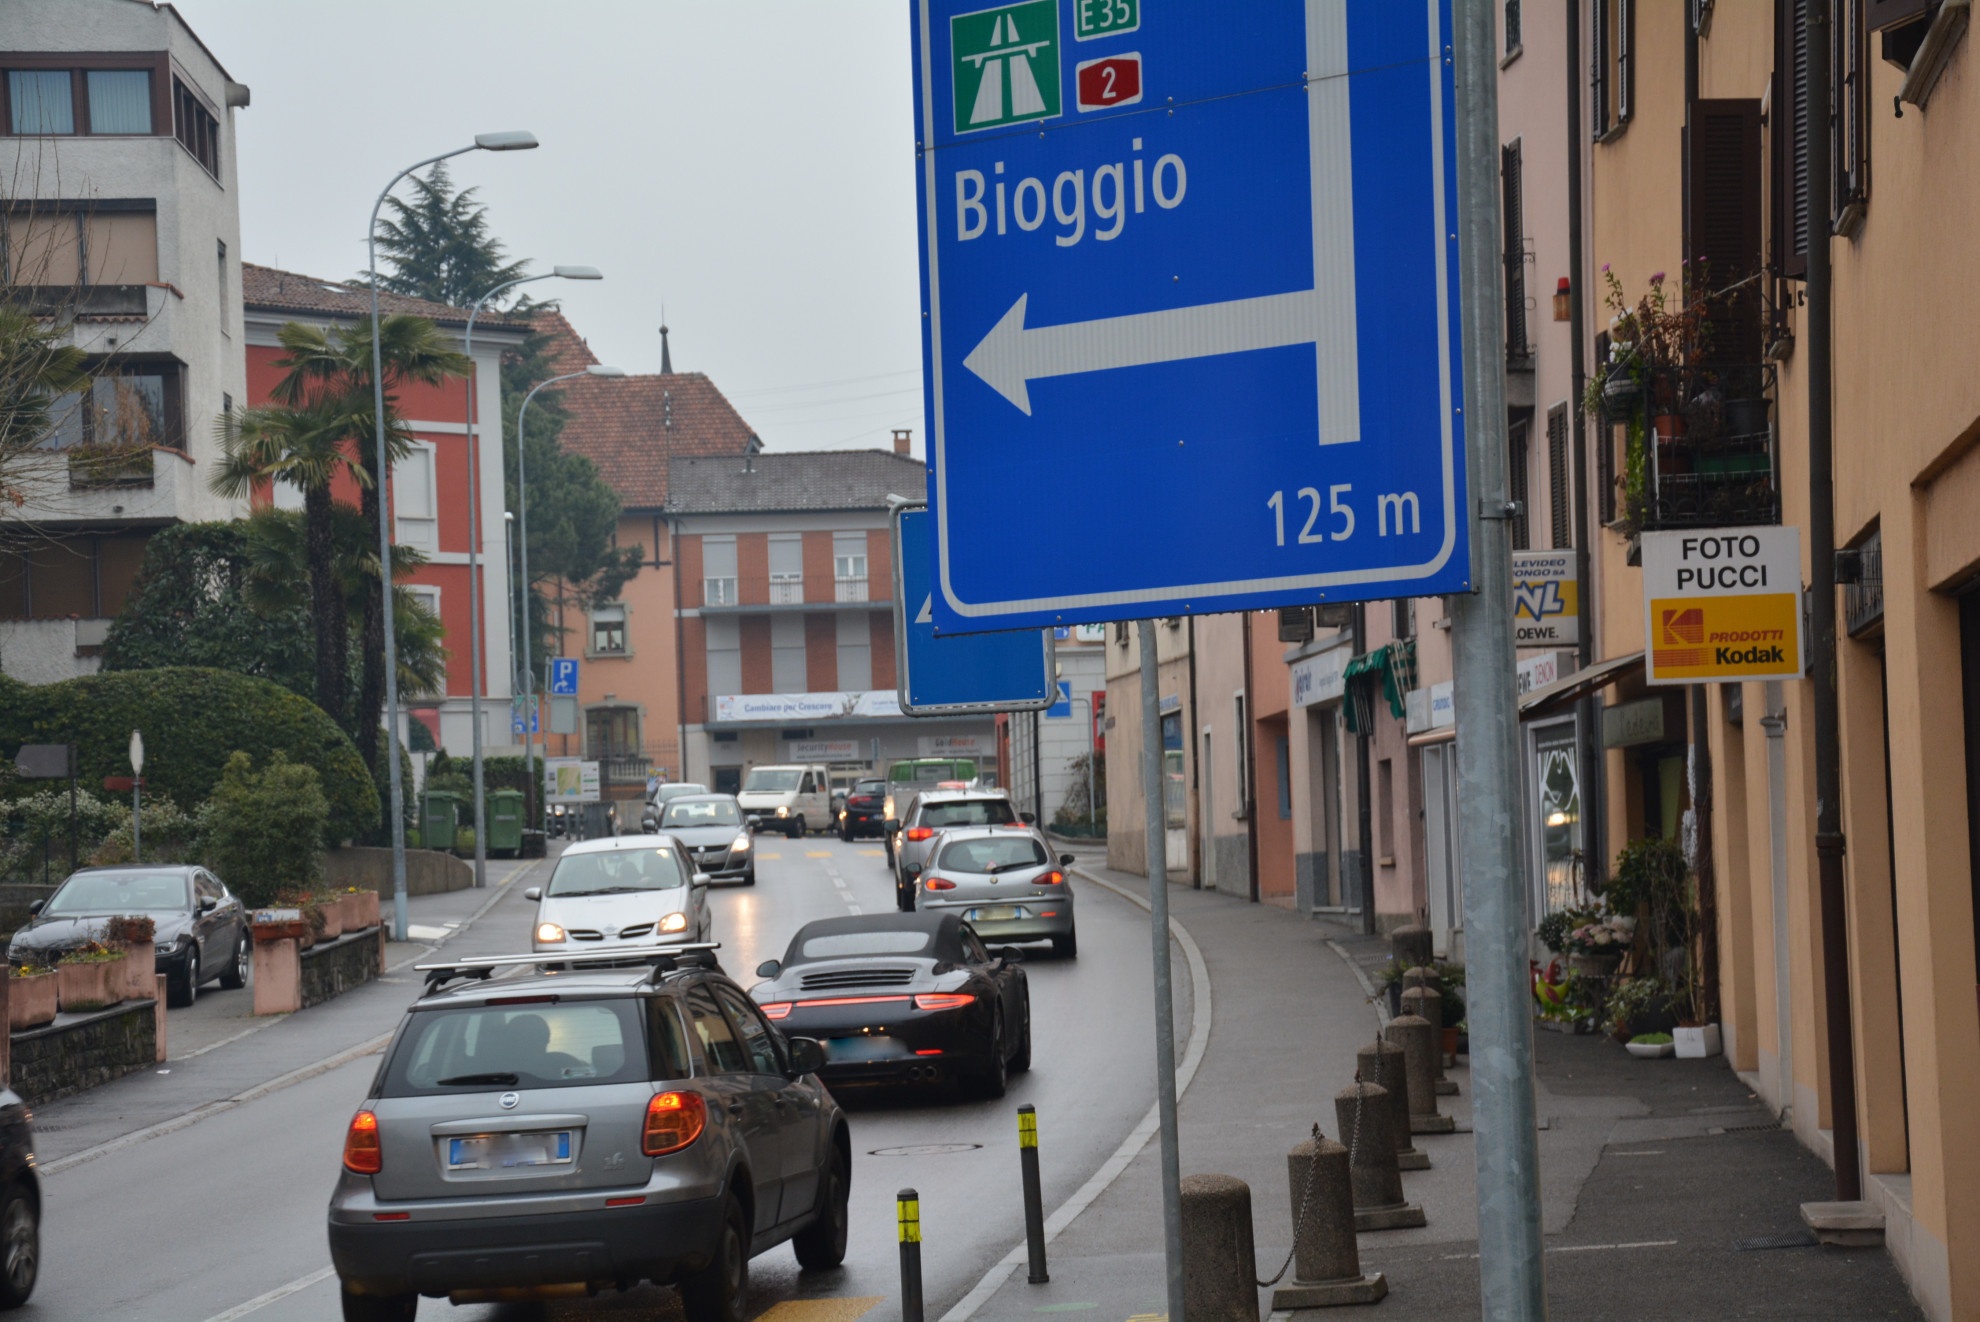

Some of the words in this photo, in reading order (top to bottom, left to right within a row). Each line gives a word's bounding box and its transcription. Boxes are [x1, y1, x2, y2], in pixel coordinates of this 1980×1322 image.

[1101, 66, 1117, 99] 2
[955, 137, 1187, 247] Bioggio
[1267, 483, 1355, 546] 125
[1377, 491, 1421, 537] m
[1682, 535, 1760, 560] FOTO
[1513, 558, 1566, 568] LEVIDEO
[1513, 569, 1551, 577] ONGO
[1677, 565, 1767, 590] PUCCI
[1514, 580, 1565, 622] NL
[1516, 627, 1559, 640] OEWE.
[1709, 629, 1784, 643] PRODOTTI
[1716, 646, 1784, 665] Kodak
[744, 704, 782, 713] Cambiare
[798, 702, 833, 711] Crescere
